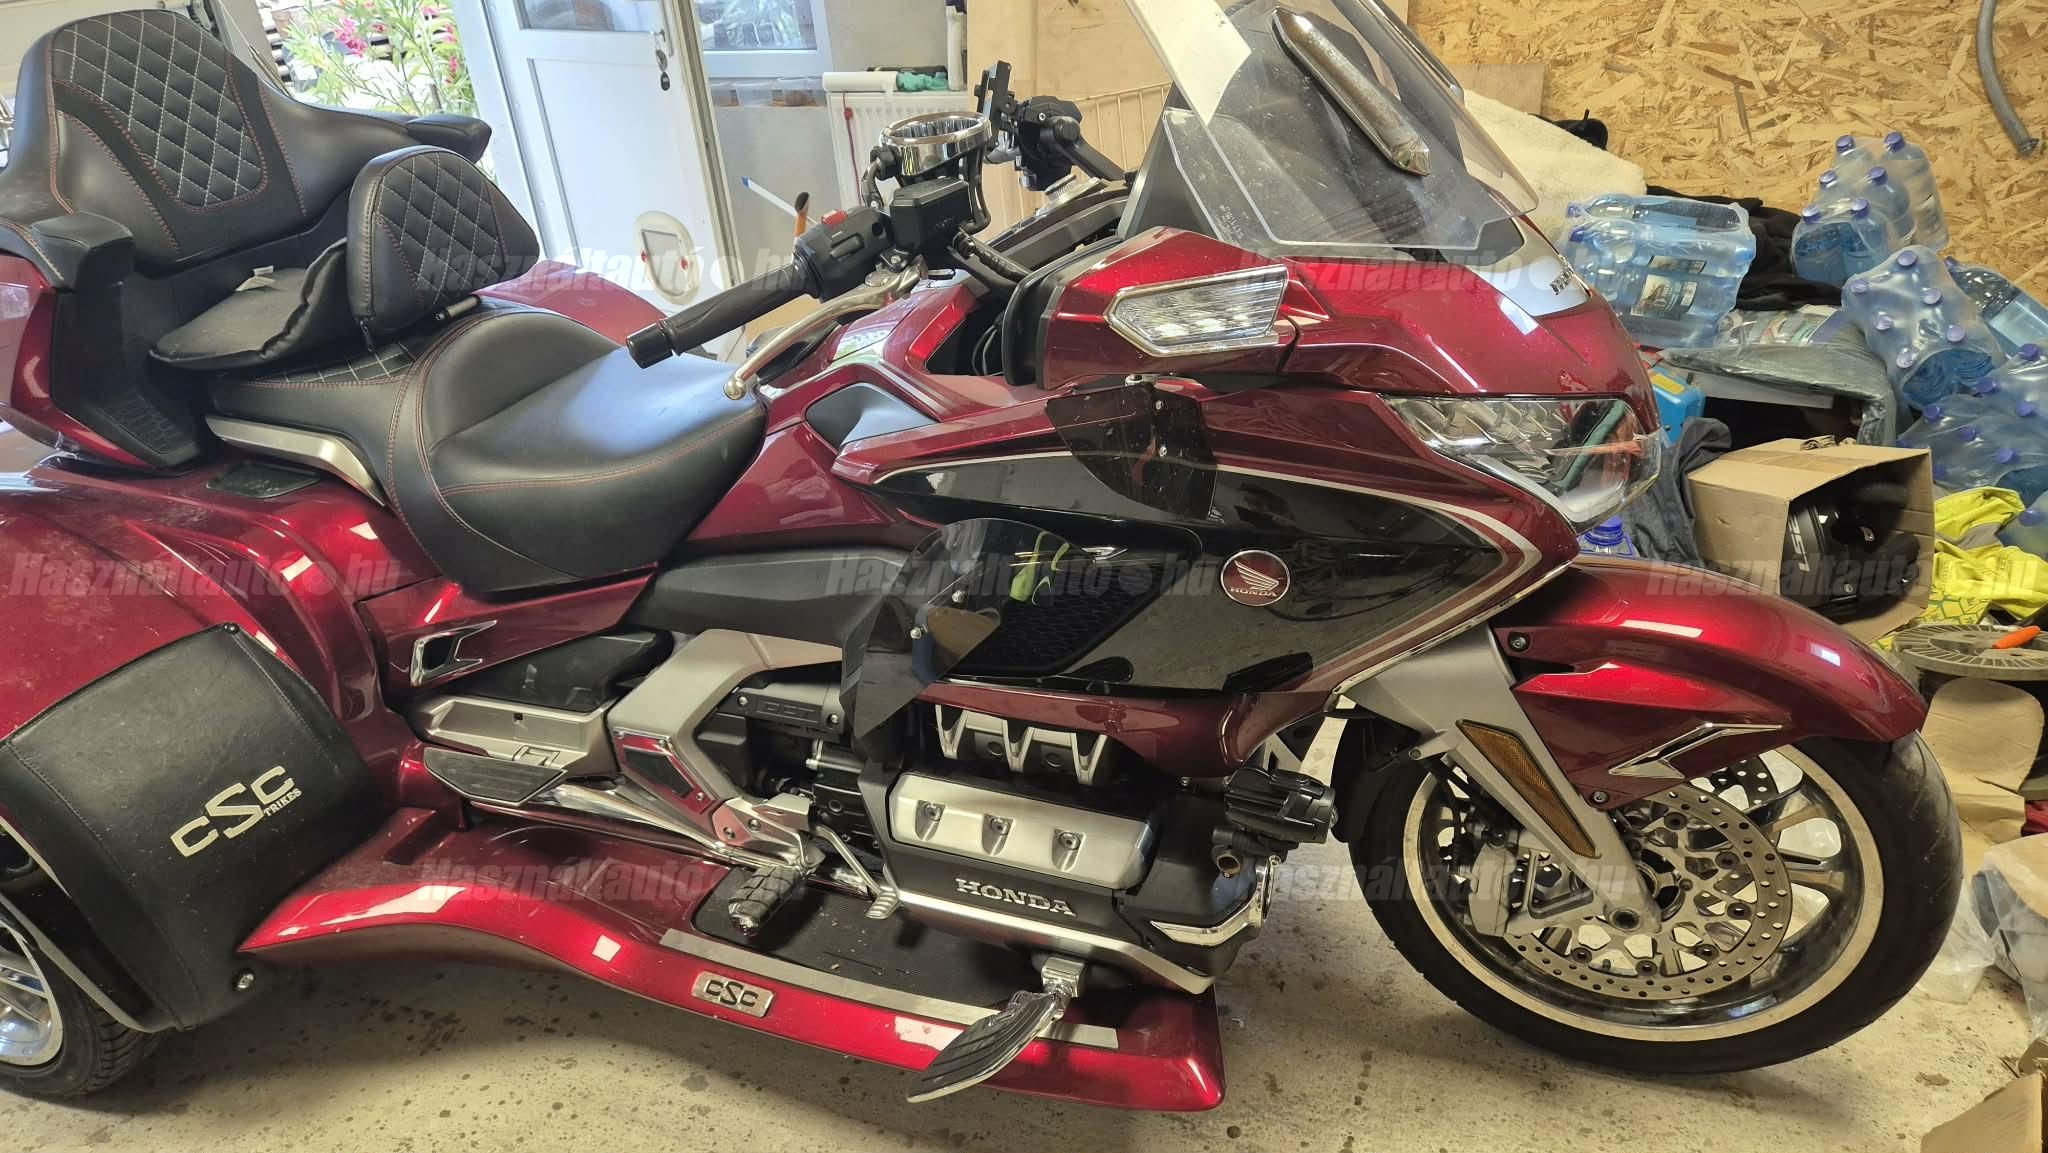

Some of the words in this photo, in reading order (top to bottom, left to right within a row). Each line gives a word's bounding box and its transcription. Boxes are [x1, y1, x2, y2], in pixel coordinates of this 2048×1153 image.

[1230, 586, 1278, 597] HONDA
[262, 787, 302, 817] TRIKES
[955, 878, 1077, 917] HONDA
